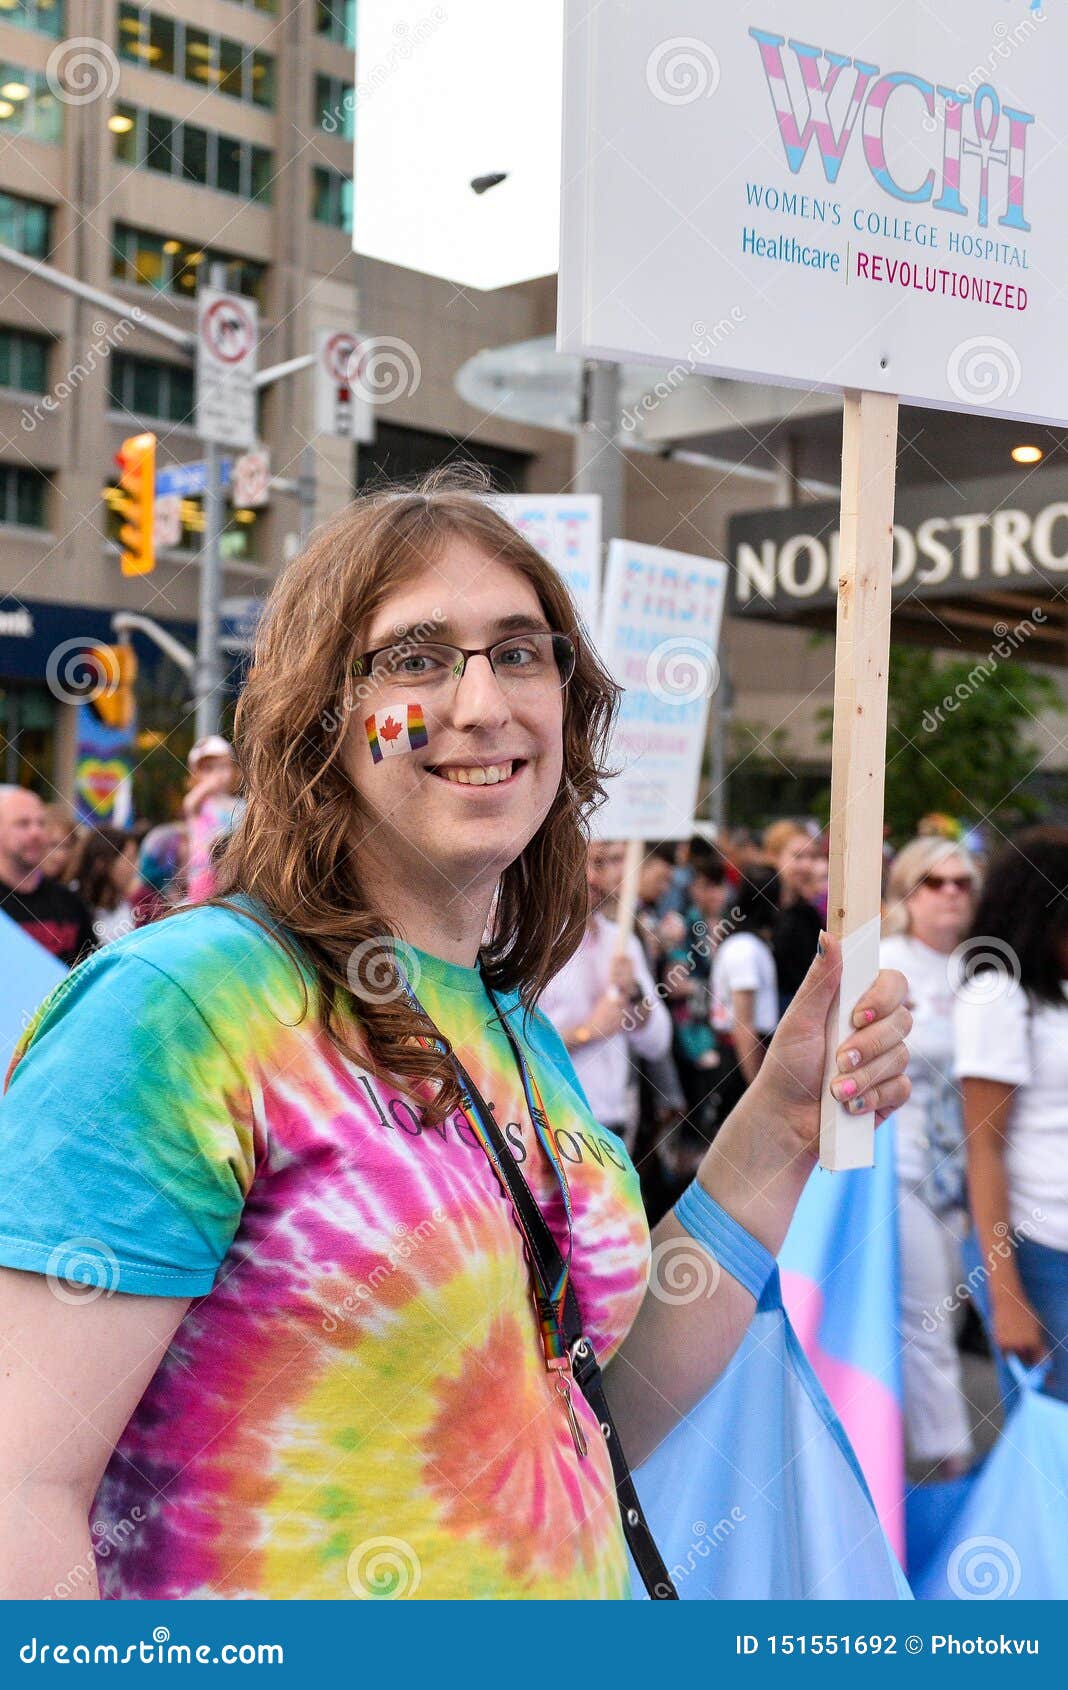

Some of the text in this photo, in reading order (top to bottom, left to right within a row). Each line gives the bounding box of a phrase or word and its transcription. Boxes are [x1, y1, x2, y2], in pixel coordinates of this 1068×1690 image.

[742, 227, 1029, 311] Healthcare REVOLUTIONIZED
[745, 183, 1031, 270] WOMEN'S COLLEGE HOSPITAL
[735, 501, 1068, 602] NODSTRO
[553, 1127, 627, 1172] ove
